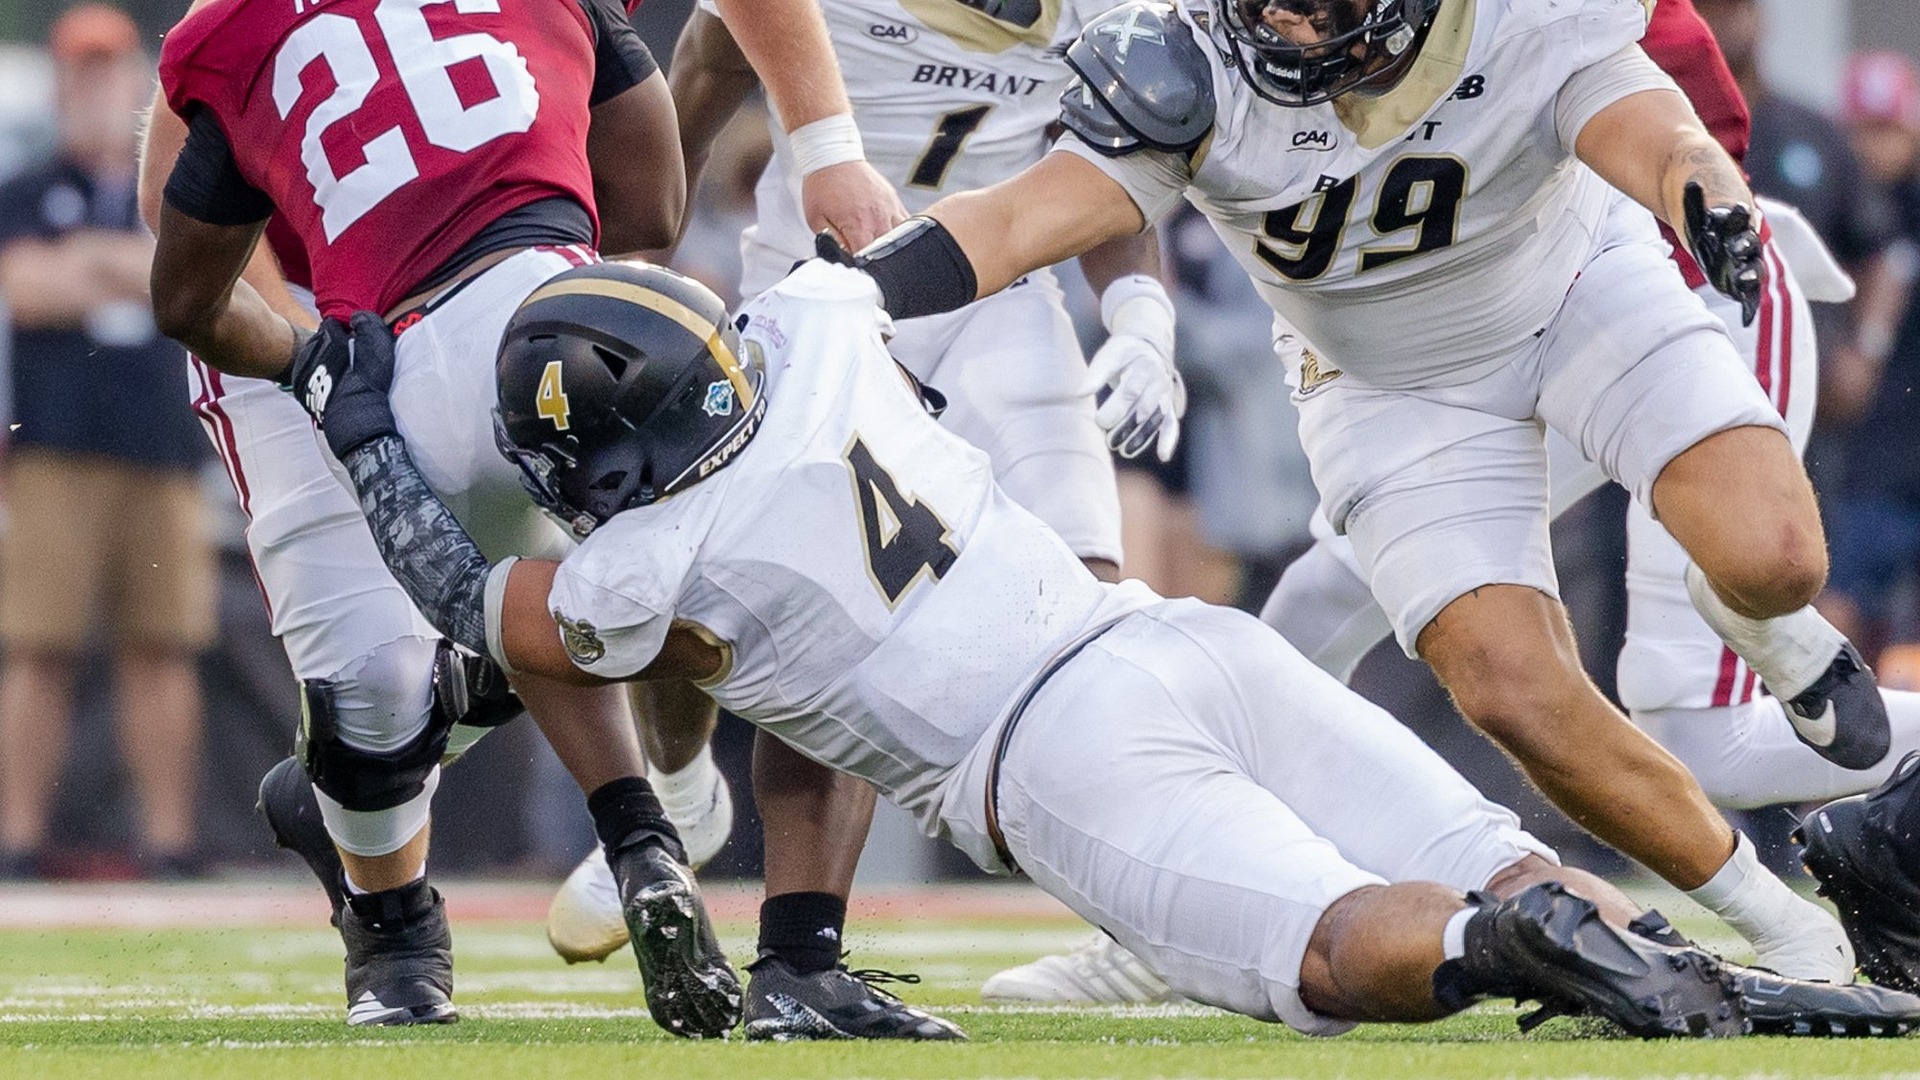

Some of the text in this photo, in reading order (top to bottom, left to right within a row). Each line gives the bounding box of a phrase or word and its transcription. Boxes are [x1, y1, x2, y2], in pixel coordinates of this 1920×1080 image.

[870, 24, 908, 39] CAA
[912, 64, 1045, 96] BRYANT
[272, 0, 540, 246] 26
[904, 101, 997, 191] 1
[1292, 130, 1329, 147] CAA
[1251, 152, 1471, 284] 99
[536, 361, 571, 431] 4
[699, 418, 755, 477] EXPECT
[840, 429, 962, 615] 4
